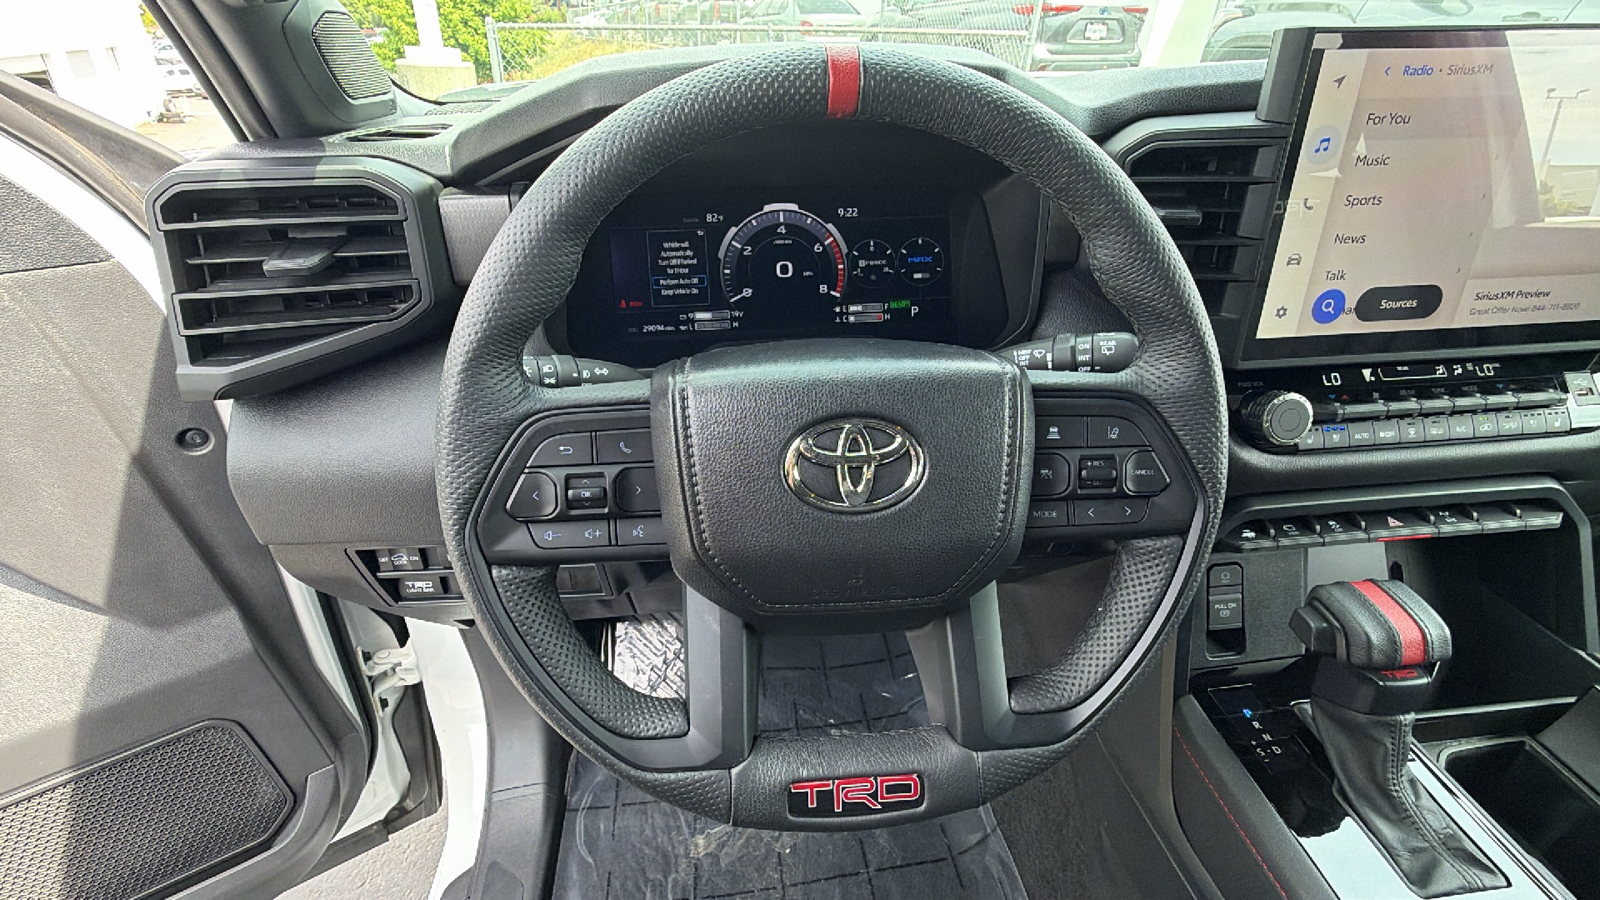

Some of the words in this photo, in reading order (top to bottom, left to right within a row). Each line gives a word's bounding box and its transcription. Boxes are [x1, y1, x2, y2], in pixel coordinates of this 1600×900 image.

[1402, 64, 1434, 77] Radio
[1447, 63, 1494, 76] SiriusXM
[1366, 112, 1387, 126] For
[1388, 112, 1411, 125] You
[1355, 154, 1391, 167] Music
[1344, 193, 1383, 208] Sports
[837, 207, 859, 218] 9:22
[776, 225, 787, 235] 4
[1334, 232, 1367, 245] News
[743, 246, 753, 256] 2
[814, 242, 823, 253] 6
[660, 249, 694, 258] Automatically
[776, 261, 794, 278] 0
[1325, 269, 1347, 281] Talk
[660, 278, 679, 286] Perform
[819, 284, 828, 294] 8
[1474, 290, 1515, 301] SiriusXM
[1515, 289, 1552, 299] Preview
[1379, 299, 1418, 309] Sources
[911, 306, 919, 318] P
[1469, 306, 1490, 316] Great
[1491, 305, 1511, 315] Offer
[1033, 510, 1058, 518] MODE
[1251, 720, 1263, 730] R
[790, 773, 921, 812] TRD
